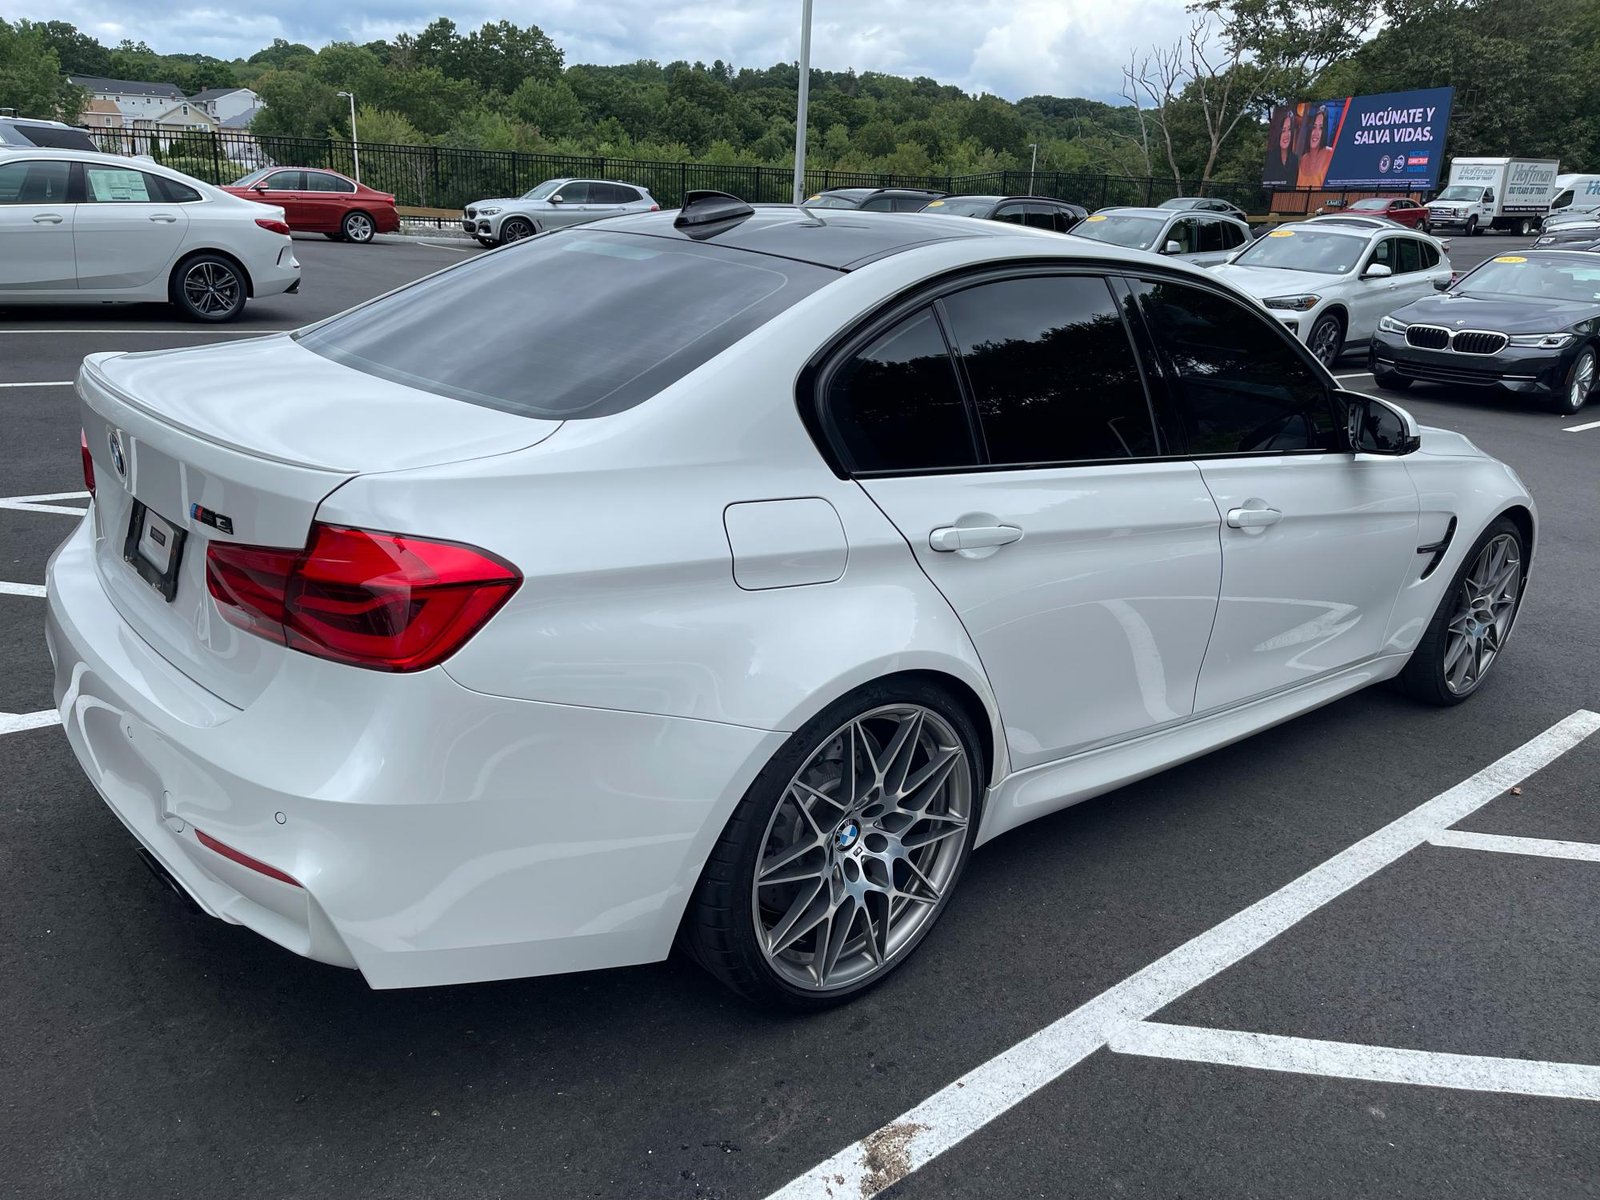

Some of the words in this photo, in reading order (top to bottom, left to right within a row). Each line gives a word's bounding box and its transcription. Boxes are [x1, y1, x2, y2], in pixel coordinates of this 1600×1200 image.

[1361, 107, 1424, 127] VACÚNATE
[1426, 107, 1436, 122] Y
[1354, 128, 1390, 145] SALVA
[1393, 126, 1434, 143] VIDAS.
[1460, 166, 1497, 176] Hoffman
[1511, 164, 1554, 186] Hoffman
[1515, 186, 1530, 195] YEARS
[1529, 186, 1535, 195] OF
[1535, 187, 1549, 195] TRUST
